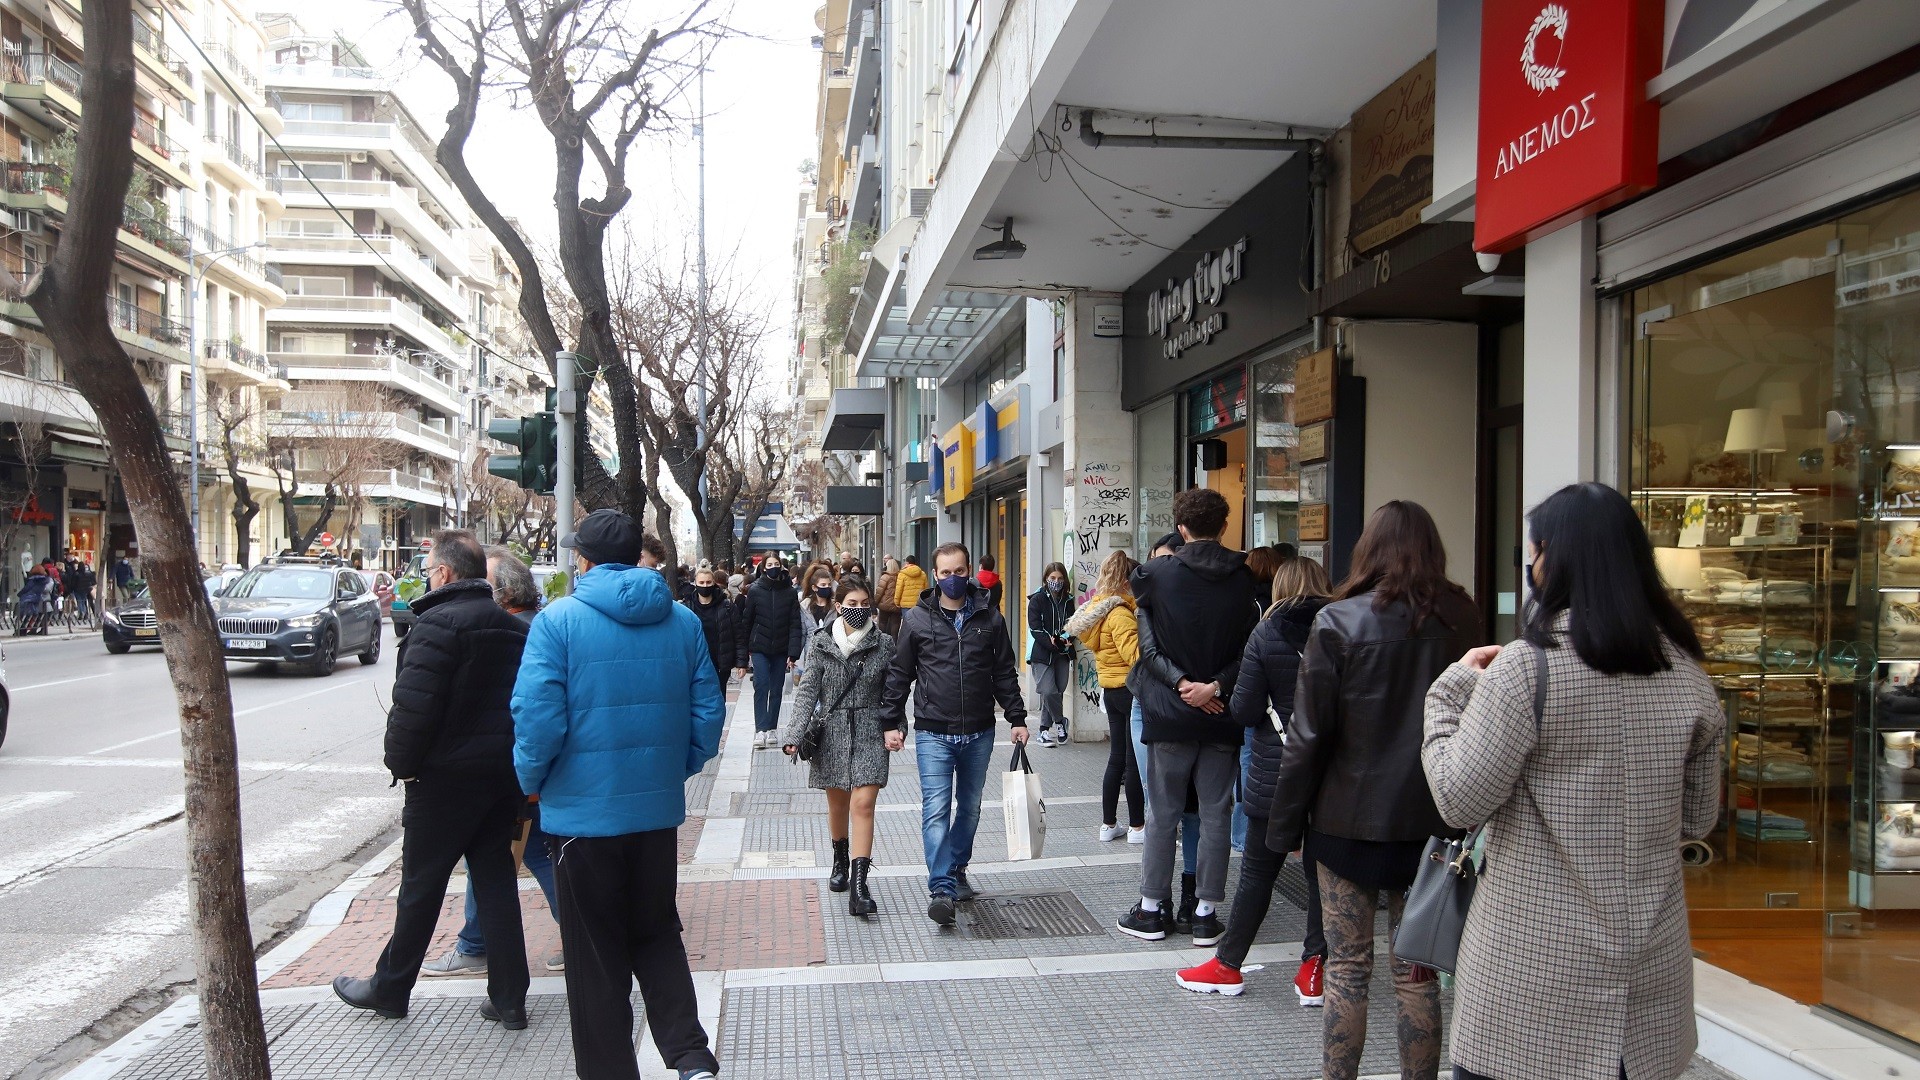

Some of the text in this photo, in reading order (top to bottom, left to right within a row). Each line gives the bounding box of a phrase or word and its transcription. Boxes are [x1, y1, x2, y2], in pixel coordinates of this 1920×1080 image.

[1494, 92, 1596, 180] ΑΝΕΜΟΣ
[1147, 236, 1246, 339] flying tiger
[1373, 250, 1390, 288] 78
[1163, 312, 1223, 360] copenhagen
